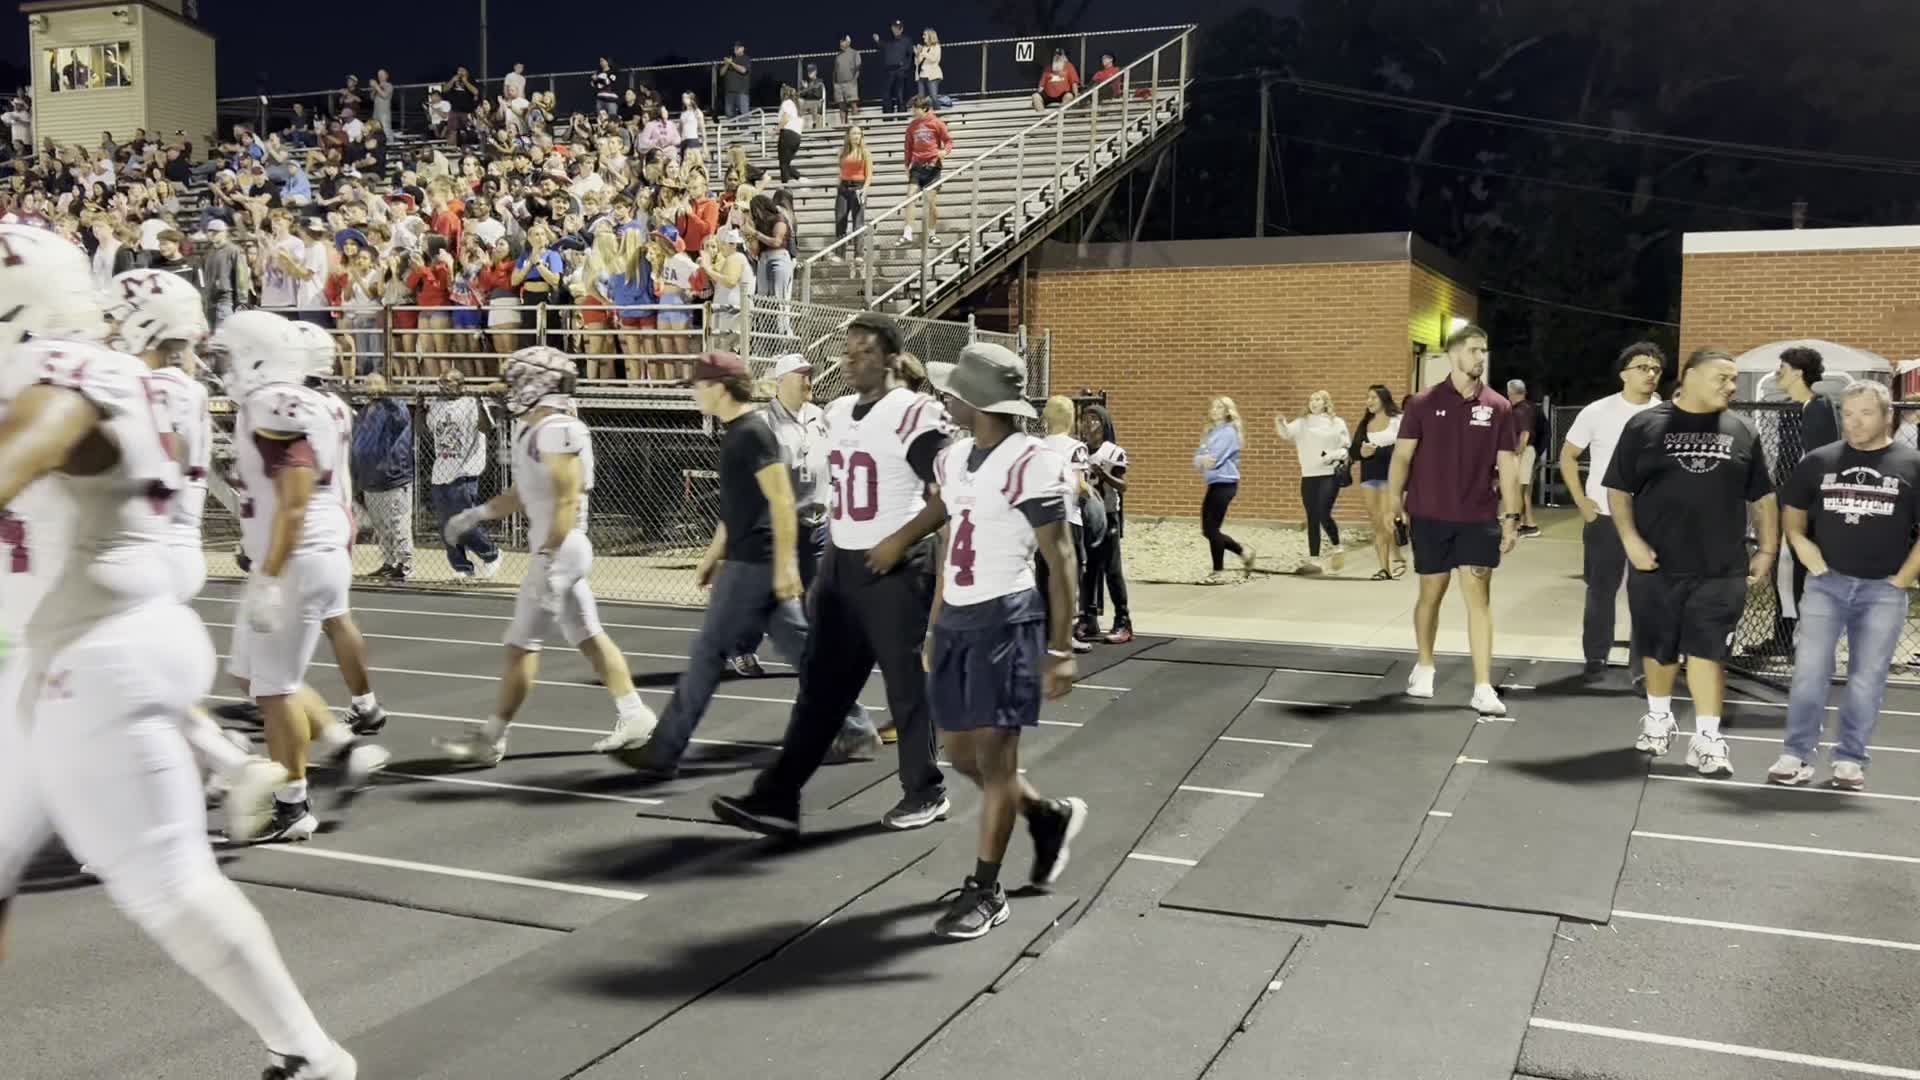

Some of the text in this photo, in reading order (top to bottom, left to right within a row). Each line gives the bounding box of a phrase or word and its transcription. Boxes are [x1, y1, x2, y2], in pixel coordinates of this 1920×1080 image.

[1017, 43, 1033, 60] M
[1666, 443, 1731, 453] FOOTBALL
[829, 450, 878, 521] 60
[950, 509, 976, 586] 4
